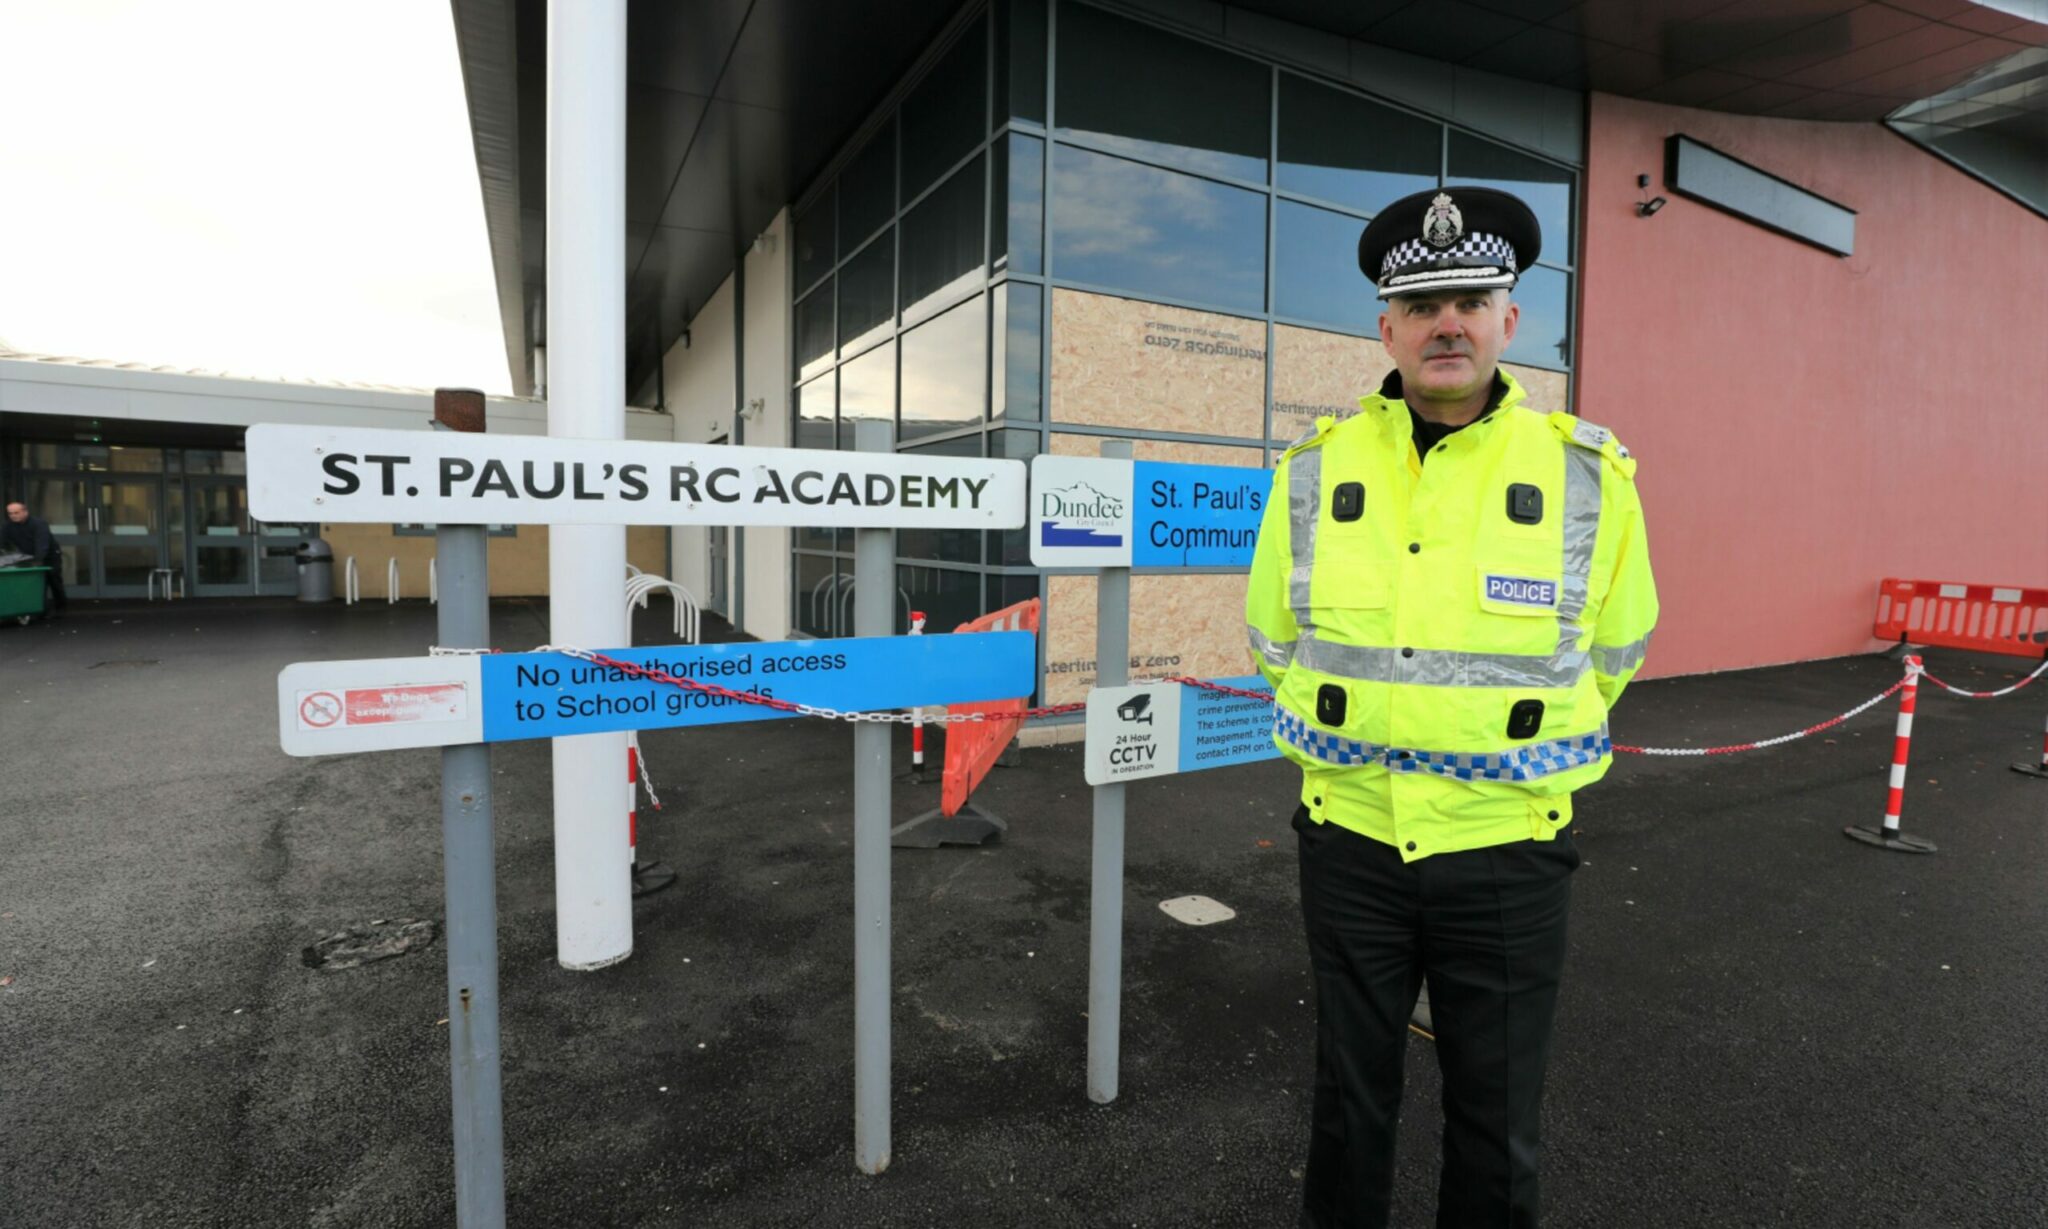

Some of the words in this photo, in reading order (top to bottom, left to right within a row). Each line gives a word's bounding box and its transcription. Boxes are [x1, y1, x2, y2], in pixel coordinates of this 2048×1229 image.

[1143, 334, 1182, 350] Zero
[1184, 339, 1267, 361] terlingOSB
[1272, 401, 1344, 419] terlingOSB
[321, 453, 419, 497] ST.
[439, 456, 650, 501] PAUL'S
[669, 465, 742, 504] RC
[752, 468, 990, 510] ACADEMY
[1151, 480, 1182, 508] St.
[1193, 482, 1261, 511] Paul's
[1041, 493, 1124, 519] Dundee
[1490, 580, 1551, 602] POLICE
[516, 664, 560, 688] No
[570, 653, 752, 685] unauthorised
[761, 653, 847, 675] access
[1146, 655, 1181, 668] Zero
[514, 698, 545, 722] to
[556, 691, 656, 719] School
[665, 683, 774, 715] grounds
[1197, 704, 1223, 716] crime
[1224, 701, 1271, 715] prevention
[1197, 720, 1214, 731] The
[1216, 717, 1250, 729] scheme
[1252, 715, 1259, 724] is
[1116, 735, 1128, 745] 24
[1130, 733, 1152, 743] Hour
[1109, 743, 1157, 765] CCTV
[1196, 747, 1230, 760] contact
[1231, 743, 1251, 755] RFM
[1253, 743, 1265, 752] on
[1120, 763, 1155, 774] OPERATION
